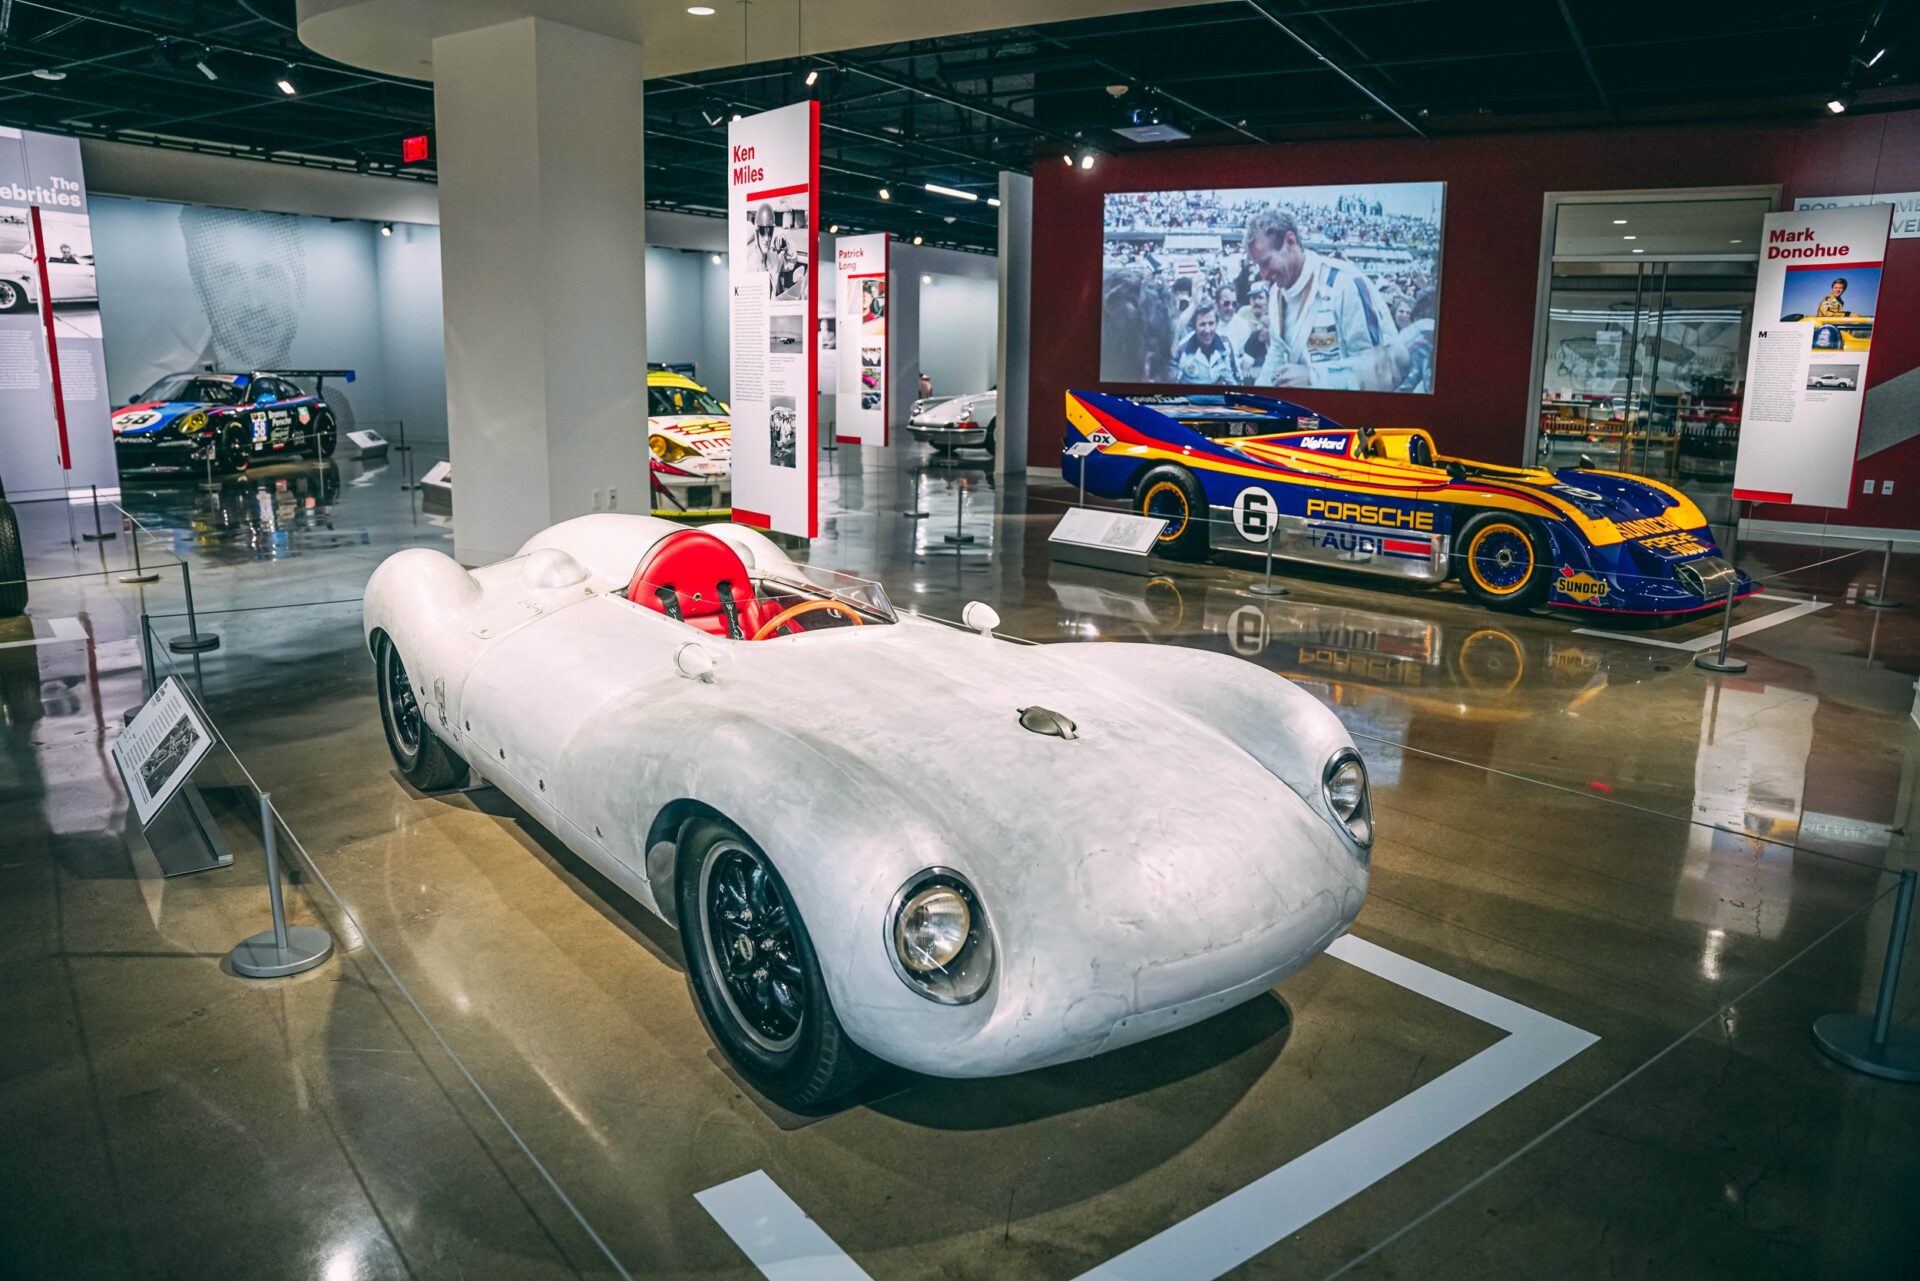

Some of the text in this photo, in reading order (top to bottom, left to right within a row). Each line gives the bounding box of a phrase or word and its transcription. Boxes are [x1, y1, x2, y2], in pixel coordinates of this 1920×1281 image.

[733, 145, 755, 163] Ken
[50, 176, 80, 192] The
[733, 166, 764, 186] Miles
[1769, 227, 1815, 243] Mark
[838, 248, 864, 259] Patrick
[1767, 243, 1850, 260] Donohue
[838, 261, 857, 271] Long
[1092, 434, 1110, 444] DX
[1300, 436, 1346, 450] DieHard
[1243, 493, 1268, 535] 6
[1306, 498, 1434, 530] PORSCHE
[1558, 579, 1606, 595] SUNOCO
